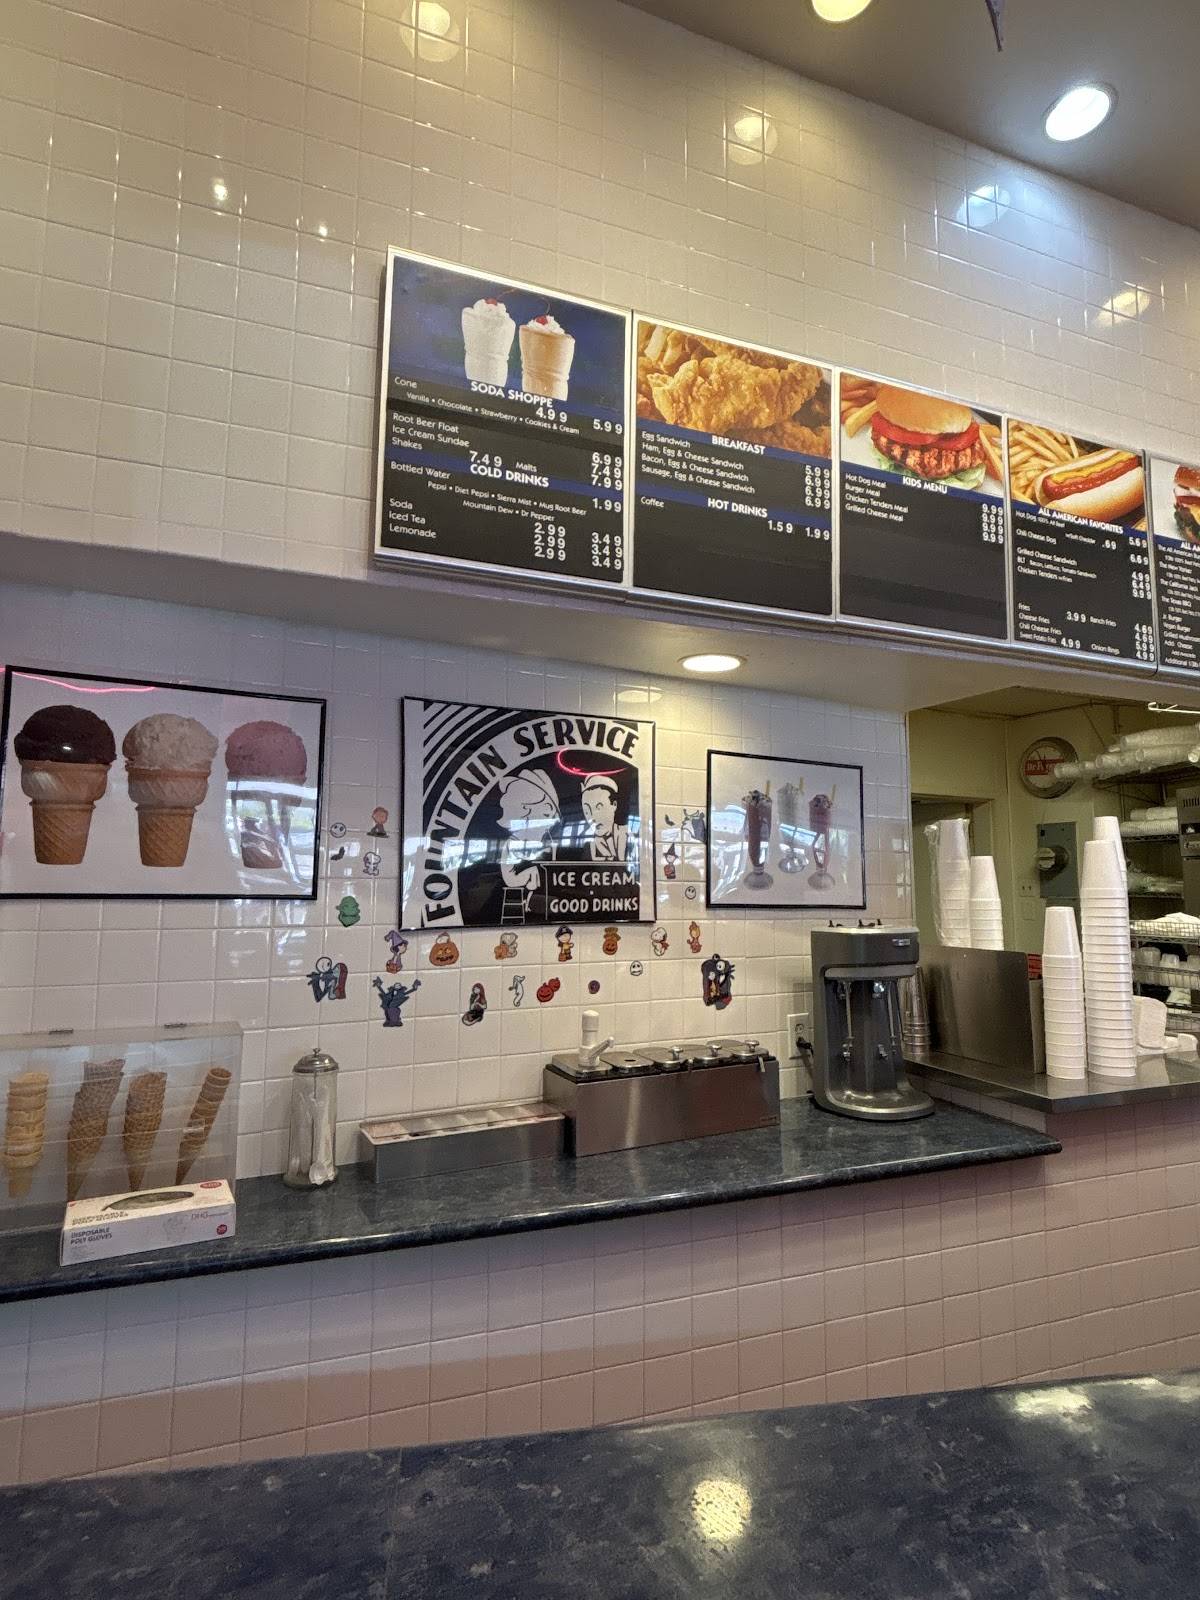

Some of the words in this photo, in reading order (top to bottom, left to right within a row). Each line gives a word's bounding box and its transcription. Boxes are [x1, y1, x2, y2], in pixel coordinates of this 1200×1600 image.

[394, 377, 417, 388] Cone
[470, 380, 505, 398] SODA
[508, 390, 553, 408] SHOPPE
[406, 392, 430, 403] Vanilla
[437, 398, 472, 412] Chocolate
[480, 407, 517, 422] Strawberry
[525, 418, 551, 430] Cookies
[560, 424, 580, 434] Cream
[393, 412, 414, 424] Root
[416, 417, 436, 428] Beer
[438, 422, 460, 434] Float
[392, 425, 405, 434] Ice
[408, 428, 435, 440] Cream
[438, 434, 470, 448] Sundae
[392, 437, 422, 450] Shakes
[642, 431, 654, 442] Egg
[656, 432, 690, 448] Sandwich
[712, 435, 766, 455] BREAKFAST
[642, 443, 660, 453] Ham,
[663, 446, 675, 457] Egg
[684, 452, 709, 463] Cheese
[711, 457, 744, 470] Sandwich
[391, 461, 423, 474] Bottled
[425, 468, 450, 479] Water
[470, 464, 502, 478] COLD
[506, 470, 550, 488] DRINKS
[516, 462, 537, 472] Malts
[642, 453, 666, 466] Bacon,
[668, 459, 680, 470] Egg
[689, 464, 714, 475] Cheese
[716, 469, 748, 482] Sandwich
[674, 471, 686, 482] Egg
[696, 476, 720, 487] Cheese
[722, 481, 756, 494] Sandwich
[846, 473, 857, 482] Hot
[858, 476, 870, 486] Dog
[872, 480, 886, 488] Meal
[902, 476, 921, 488] KIDS
[924, 482, 948, 494] MENU
[428, 481, 447, 490] Pepsi
[455, 486, 469, 495] Diet
[471, 489, 490, 498] Pepsi
[497, 494, 516, 504] Sierra
[518, 499, 532, 507] Mist
[539, 502, 554, 512] Mug
[555, 504, 570, 513] Root
[845, 483, 864, 494] Burger
[866, 489, 880, 497] Meal
[390, 498, 412, 510] Soda
[463, 500, 496, 512] Mountain
[498, 506, 514, 514] Dew
[531, 512, 555, 522] Pepper
[640, 496, 664, 508] Coffee
[708, 498, 729, 510] HOT
[732, 502, 768, 518] DRINKS
[845, 493, 869, 504] Chicken
[870, 498, 893, 510] Tenders
[894, 504, 908, 513] Meal
[389, 510, 408, 521] Iced
[411, 514, 426, 524] Tea
[845, 504, 866, 514] Grilled
[867, 508, 888, 518] Cheese
[889, 513, 904, 522] Meal
[1038, 507, 1050, 517] ALL
[1052, 511, 1088, 526] AMERICAN
[1089, 520, 1124, 534] FAVORITES
[390, 523, 436, 538] Lemonade
[1046, 536, 1056, 544] Dog
[423, 745, 507, 922] FOUNTAIN
[514, 718, 639, 758] SERVICE
[552, 872, 576, 886] ICE
[582, 872, 636, 886] CREAM
[550, 898, 589, 913] GOOD
[592, 897, 638, 912] DRINKS
